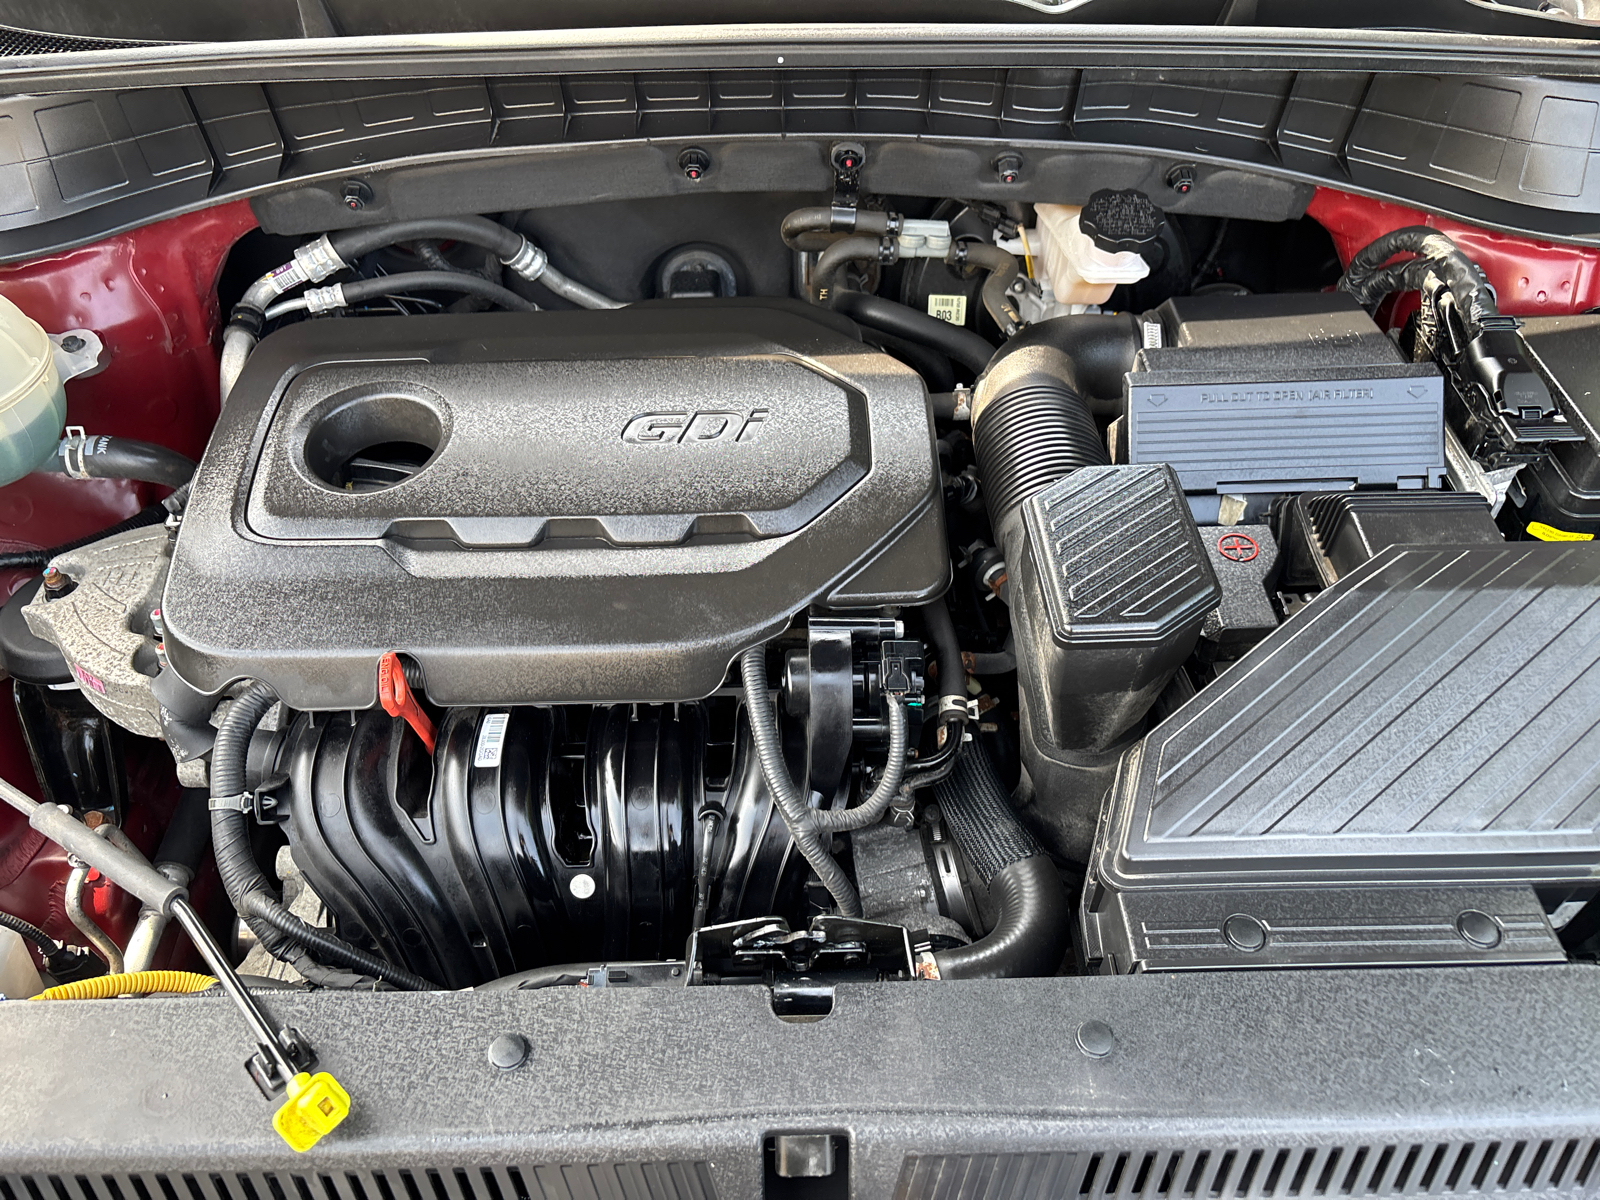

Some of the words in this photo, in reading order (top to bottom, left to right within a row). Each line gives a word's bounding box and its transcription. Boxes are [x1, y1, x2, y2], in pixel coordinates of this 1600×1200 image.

[1200, 393, 1229, 404] PULL
[1230, 391, 1254, 403] OUT
[1256, 391, 1270, 402] TO
[1272, 390, 1304, 402] OPEN
[620, 408, 769, 444] GDi
